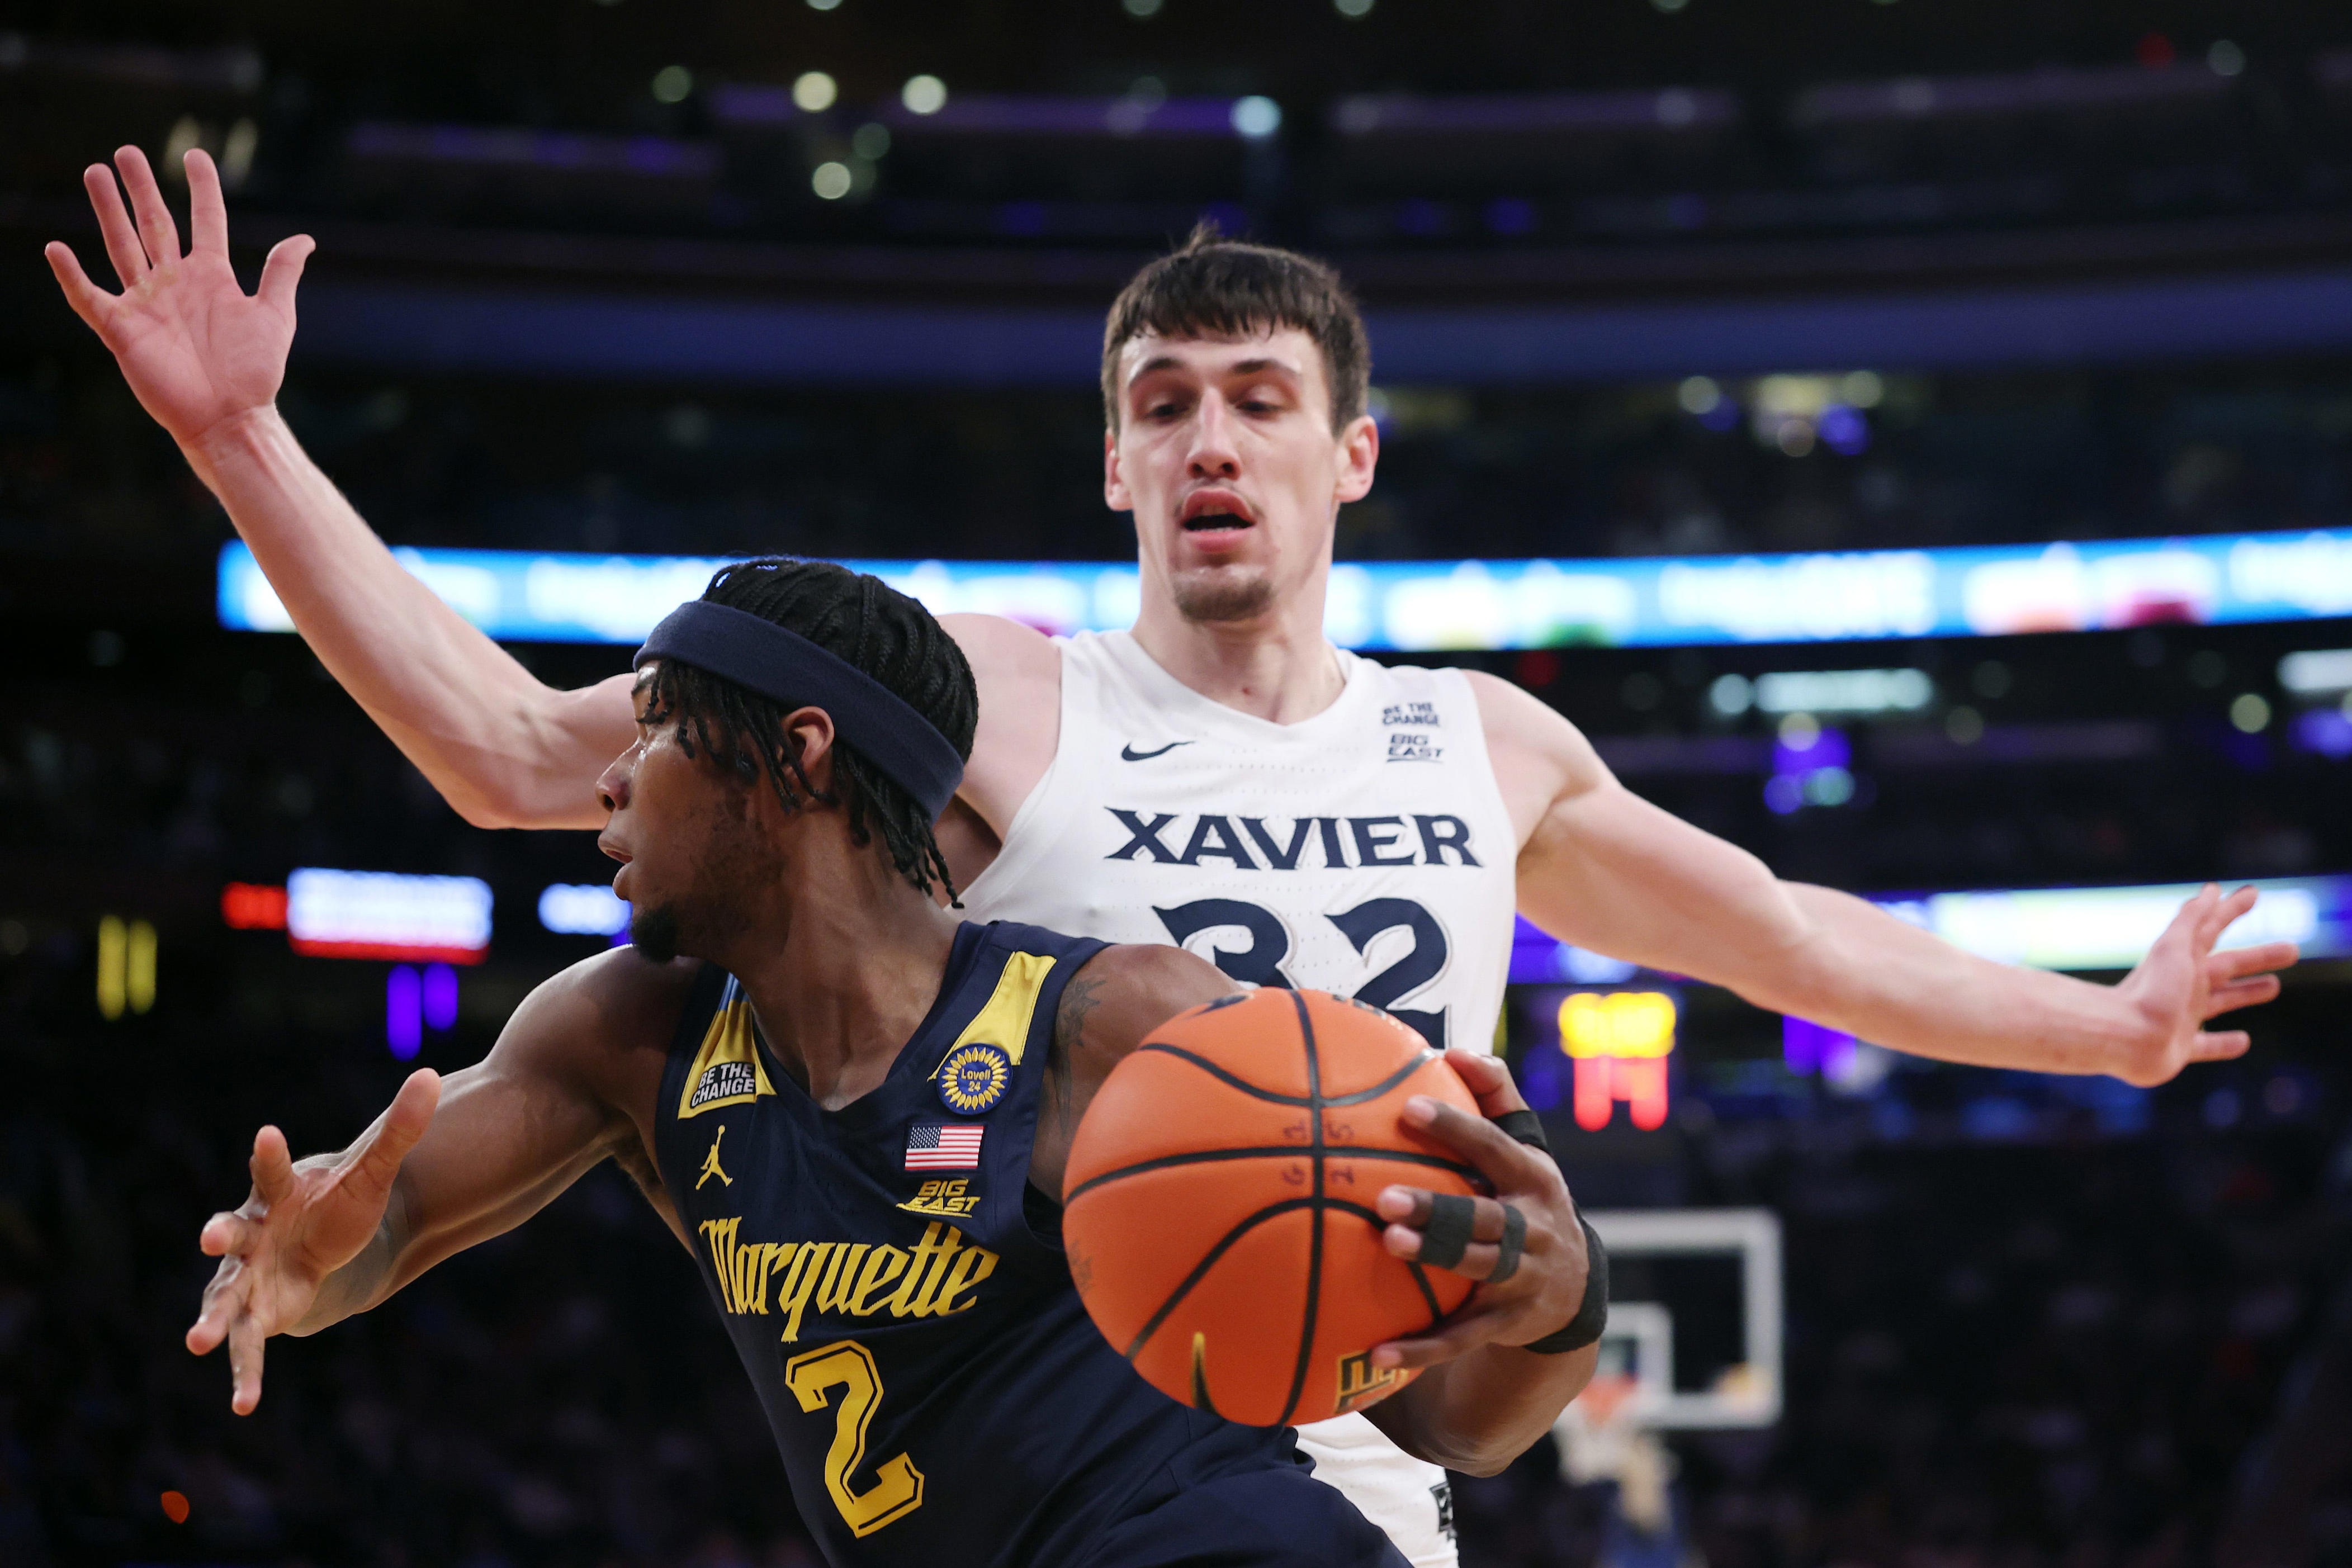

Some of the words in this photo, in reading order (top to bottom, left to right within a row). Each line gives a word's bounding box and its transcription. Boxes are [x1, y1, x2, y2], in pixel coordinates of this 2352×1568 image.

[1383, 714, 1440, 726] CHANGE
[1391, 734, 1428, 745] BIG
[1388, 746, 1444, 757] EAST
[1104, 807, 1484, 870] XAVIER
[1152, 898, 1448, 1050] 32
[698, 1067, 716, 1089] BE
[720, 1062, 753, 1080] THE
[960, 1067, 991, 1081] Lovell
[691, 1078, 755, 1108] CHANGE
[968, 1081, 981, 1092] 24
[918, 1179, 969, 1197] BIG
[904, 1196, 982, 1212] EAST
[698, 1216, 1000, 1342] Marquette
[785, 1339, 925, 1539] 2
